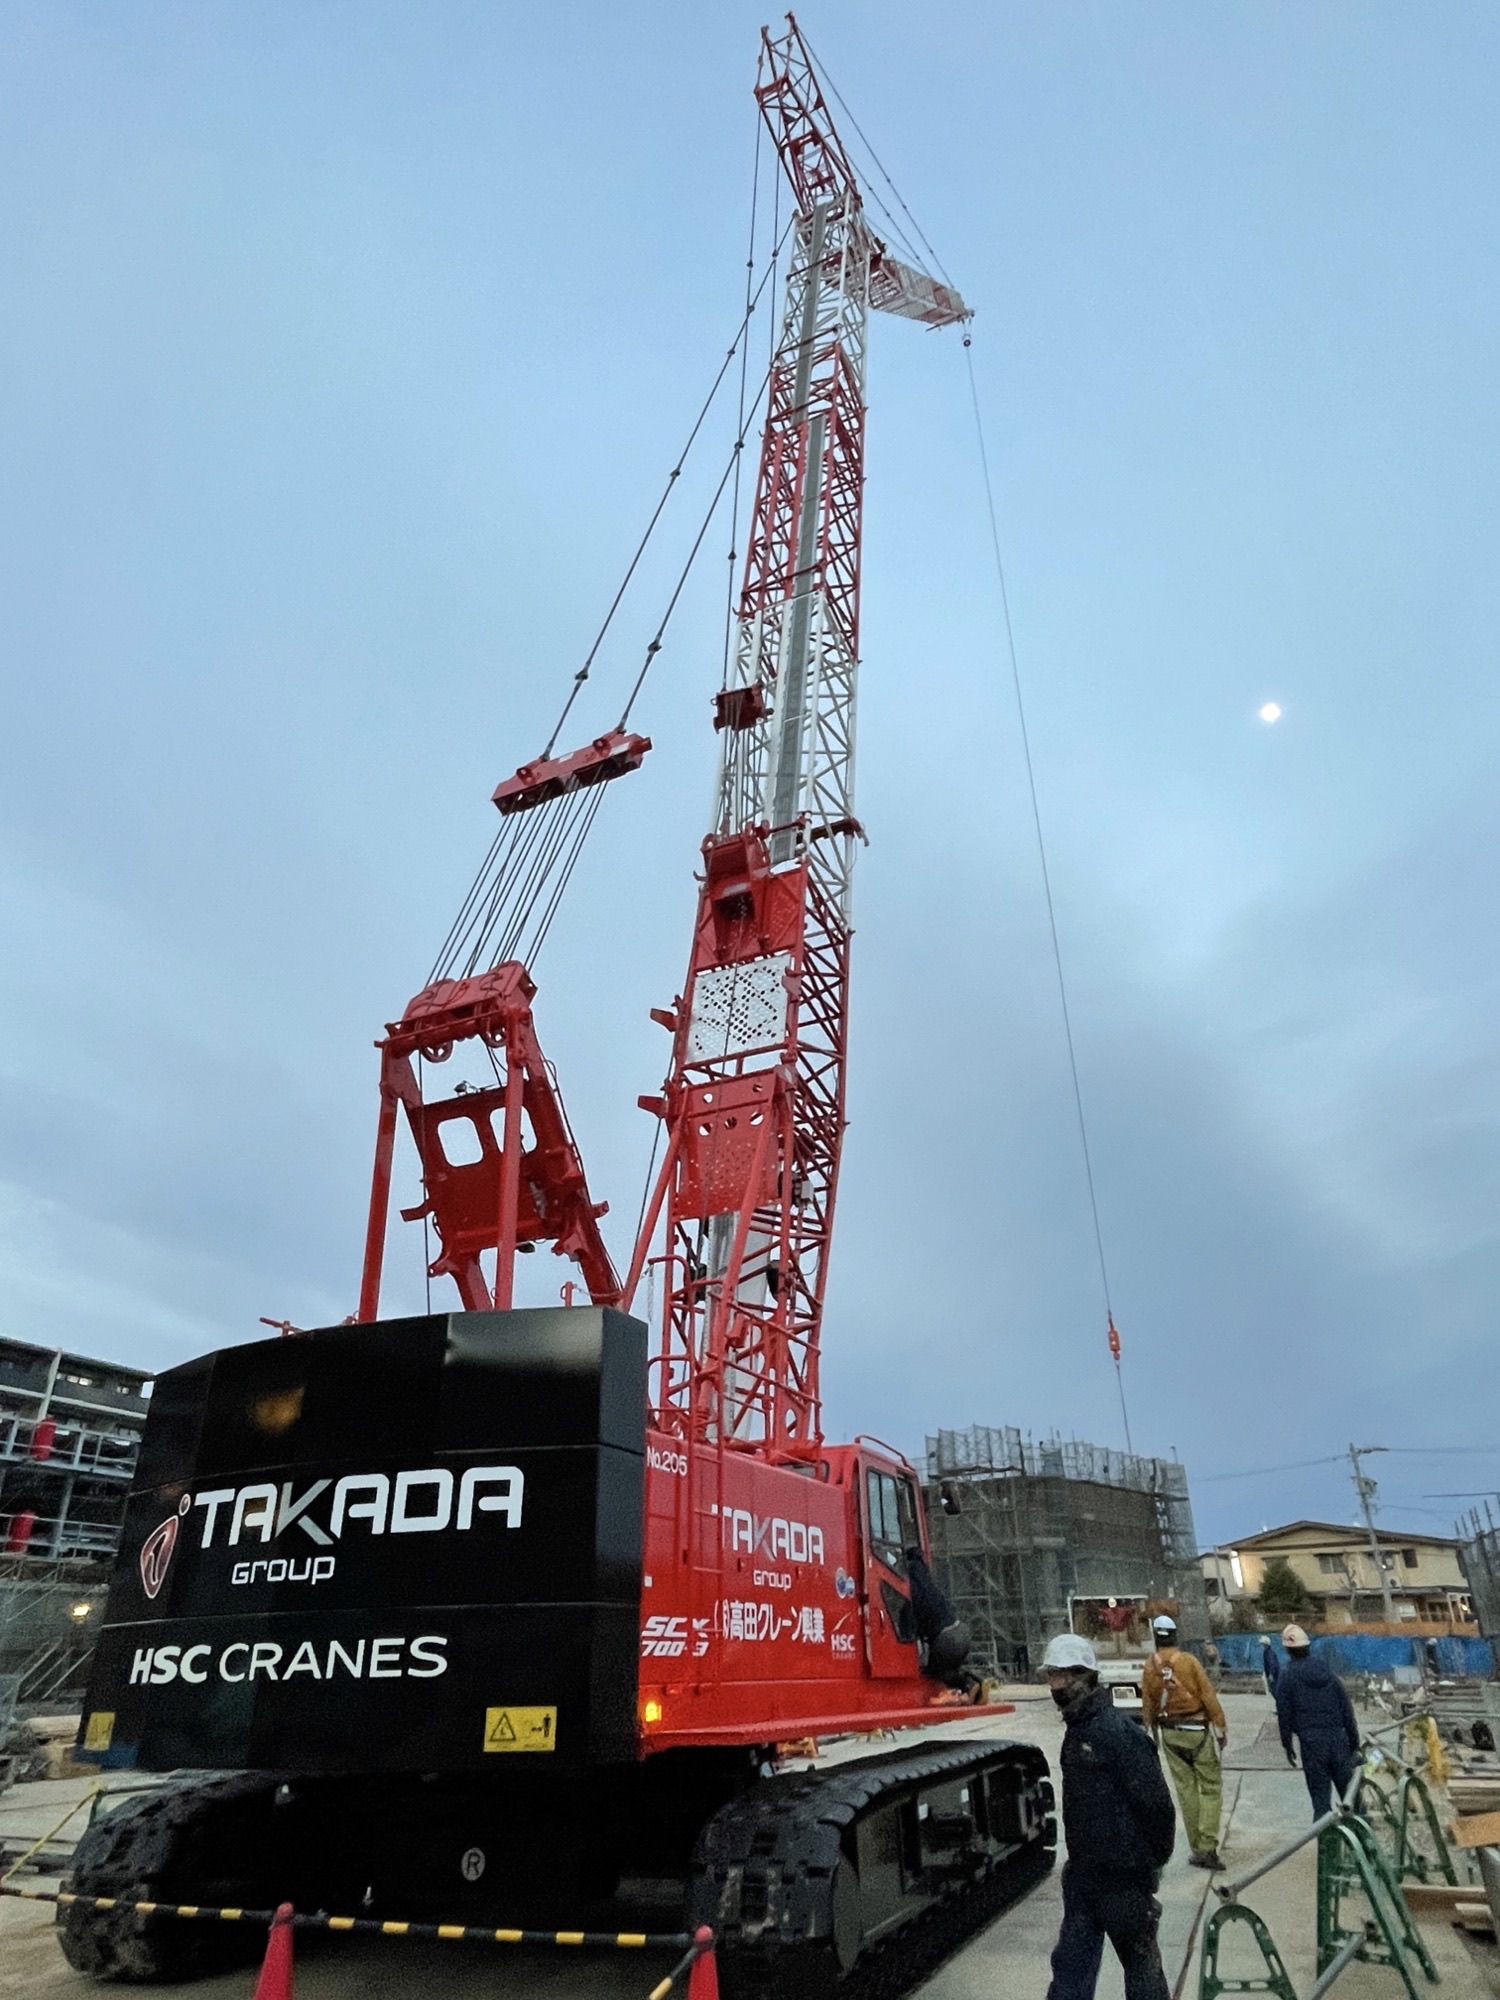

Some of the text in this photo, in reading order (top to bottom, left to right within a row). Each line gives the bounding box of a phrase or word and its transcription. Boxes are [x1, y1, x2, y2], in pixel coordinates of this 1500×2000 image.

[194, 1465, 525, 1549] TAKADA
[711, 1503, 825, 1566] TAKADA
[231, 1556, 336, 1586] Group
[129, 1635, 449, 1685] HSC CRANES
[830, 1633, 856, 1651] HSC
